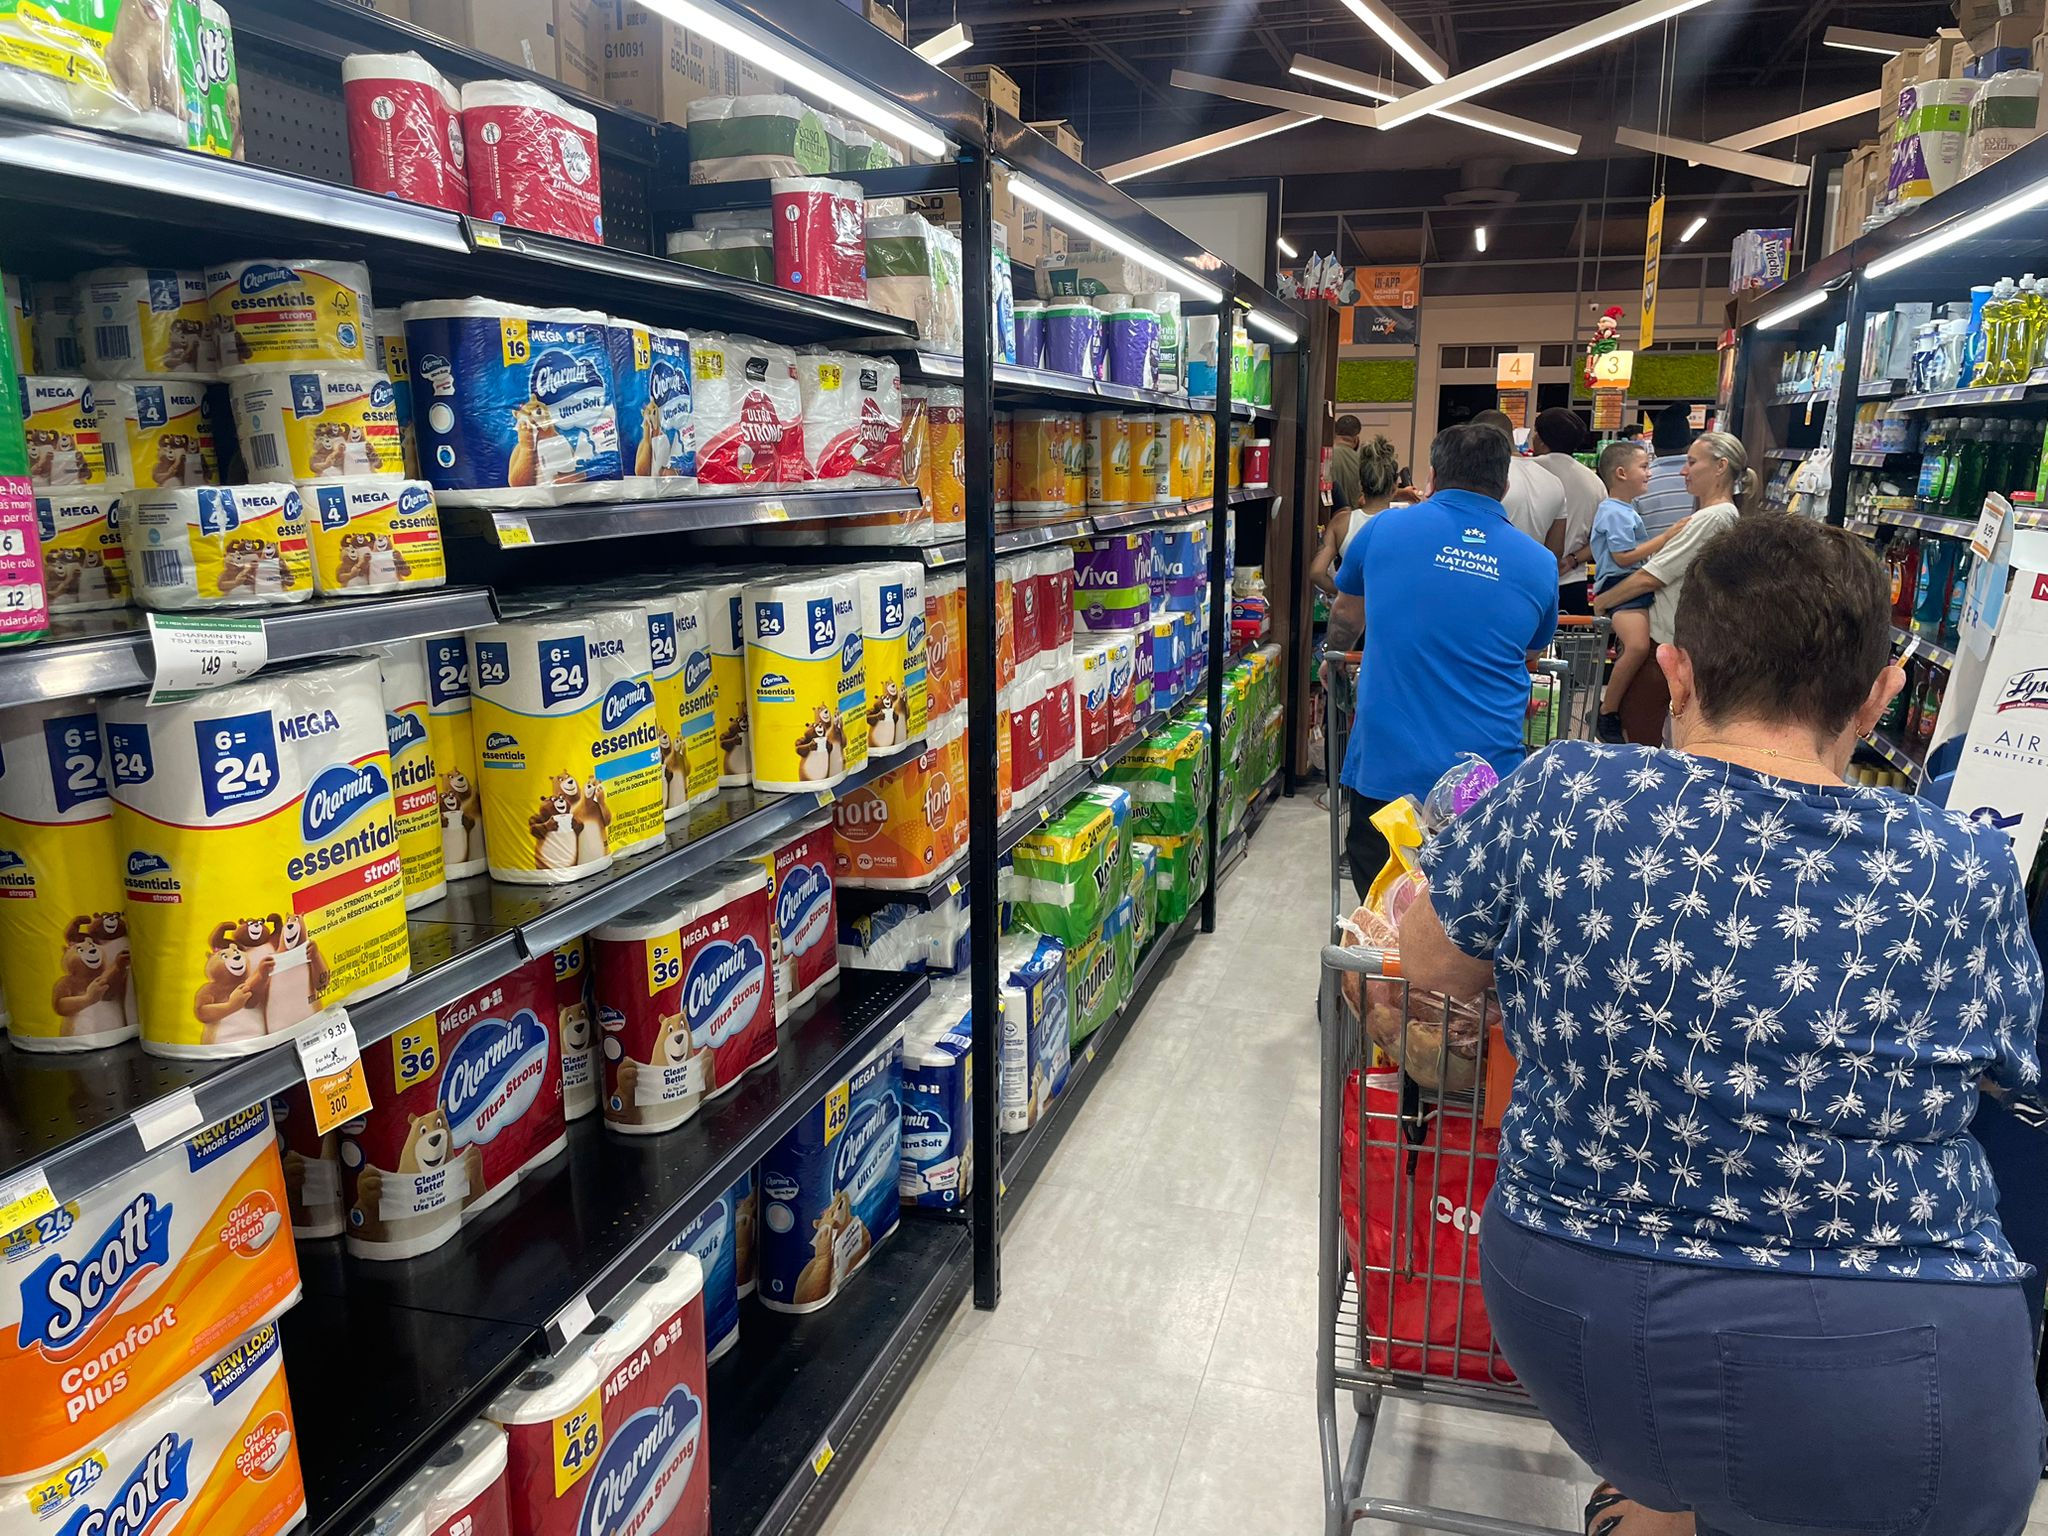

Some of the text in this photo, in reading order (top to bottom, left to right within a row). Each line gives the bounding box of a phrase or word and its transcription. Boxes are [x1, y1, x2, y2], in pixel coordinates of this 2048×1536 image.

[604, 42, 644, 59] G10091
[66, 55, 75, 77] 4
[1766, 241, 1780, 277] Welch's
[243, 269, 287, 289] Charmin
[1375, 277, 1400, 289] IN-APP
[231, 292, 315, 310] essentials
[279, 311, 313, 321] strong
[531, 330, 564, 343] MEGA
[507, 340, 525, 358] 16
[1509, 358, 1521, 376] 4
[1607, 356, 1619, 375] 3
[328, 383, 363, 393] MEGA
[536, 363, 590, 398] Charmin
[652, 370, 682, 400] Charmin
[36, 387, 74, 398] MEGA
[170, 395, 196, 406] MEGA
[146, 406, 160, 420] 4
[301, 396, 316, 410] 4
[559, 395, 604, 418] Ultra Soft
[747, 408, 772, 423] ULTRA
[740, 422, 783, 443] STRONG
[9, 482, 32, 496] Rolls
[352, 492, 391, 504] MEGA
[11, 500, 32, 512] many
[60, 504, 100, 517] MEGA
[242, 496, 278, 508] MEGA
[3, 513, 33, 525] per roll
[327, 508, 341, 521] 4
[3, 535, 12, 551] 6
[18, 558, 36, 569] rolls
[1435, 553, 1500, 576] NATIONAL
[1442, 546, 1498, 565] CAYMAN
[1074, 565, 1118, 588] Viva
[7, 591, 25, 607] 12
[834, 599, 853, 615] MEGA
[885, 603, 902, 623] 24
[651, 622, 665, 633] 6=
[676, 615, 697, 632] MEGA
[760, 617, 781, 632] 24
[814, 621, 834, 642] 24
[439, 648, 460, 661] 6=
[550, 648, 571, 662] 6=
[588, 639, 625, 659] MEGA
[651, 637, 674, 661] 24
[481, 663, 505, 679] 24
[550, 665, 584, 693] 24
[756, 687, 795, 696] essentials
[606, 683, 647, 723] Charmin
[279, 710, 340, 743] MEGA
[64, 728, 97, 748] 6=
[214, 730, 247, 749] 6=
[486, 733, 511, 747] Charmin
[1995, 730, 2041, 752] AIR
[114, 753, 147, 777] 24
[482, 750, 526, 761] essentials
[1127, 755, 1155, 764] TRIPLES
[214, 752, 272, 795] 24
[309, 770, 375, 829] Charmin
[402, 788, 437, 811] strong
[923, 781, 951, 826] fiora
[1131, 806, 1149, 820] unty
[287, 814, 401, 882] essentials
[130, 856, 158, 872] Charmin
[364, 856, 401, 884] strong
[776, 851, 795, 871] MEGA
[9, 889, 34, 898] strong
[124, 877, 181, 891] essentials
[152, 893, 179, 903] strong
[325, 908, 335, 918] Big
[343, 892, 373, 910] STRENGTH,
[373, 886, 388, 897] Small
[780, 870, 819, 928] Charmin
[307, 924, 326, 937] Encore
[327, 918, 339, 931] plus
[384, 893, 394, 905] PRIX
[794, 901, 829, 946] Ultra Strong
[682, 925, 710, 950] MEGA
[555, 952, 580, 974] 36
[653, 947, 669, 959] 9=
[652, 957, 679, 983] 36
[688, 943, 748, 1018] Charmin
[1074, 941, 1116, 1027] Bounty
[709, 978, 761, 1036] Ultra Strong
[327, 1022, 346, 1039] 9.39
[439, 1006, 478, 1036] MEGA
[401, 1035, 422, 1050] 9=
[316, 1055, 348, 1073] Members Only
[400, 1053, 435, 1079] 36
[448, 1022, 524, 1114] Charmin
[562, 1053, 588, 1065] Cleans
[563, 1061, 587, 1073] Better
[663, 1065, 688, 1078] Cleans
[664, 1073, 687, 1086] Better
[851, 1065, 876, 1094] MEGA
[476, 1057, 544, 1132] Ultra Strong
[662, 1088, 688, 1100] Use Less
[330, 1095, 348, 1115] 300
[229, 1110, 265, 1140] COMFORT
[828, 1107, 847, 1130] 48
[191, 1123, 227, 1150] NEW
[838, 1100, 887, 1181] Charmin
[921, 1138, 942, 1148] Soft
[414, 1169, 446, 1187] Cleans
[857, 1160, 878, 1192] Ultra
[415, 1179, 445, 1196] Better
[20, 1187, 50, 1210] 14.59
[413, 1196, 446, 1213] Use Less
[228, 1202, 251, 1223] Our
[36, 1206, 73, 1245] 24
[220, 1207, 265, 1244] Softest
[228, 1222, 265, 1251] Clean
[48, 1193, 151, 1343] Scott
[59, 1303, 178, 1395] Comfort
[210, 1346, 245, 1380] NEW
[242, 1323, 275, 1357] LOOK
[246, 1333, 276, 1368] COMFORT
[604, 1348, 651, 1404] MEGA
[66, 1369, 129, 1423] Plus
[242, 1424, 266, 1446] Our
[235, 1428, 279, 1471] Softest
[562, 1423, 598, 1470] 48
[242, 1444, 276, 1476] Clean
[594, 1402, 676, 1527] Charmin
[654, 1434, 696, 1502] Strong
[65, 1460, 104, 1498] 24
[78, 1433, 174, 1536] Scott
